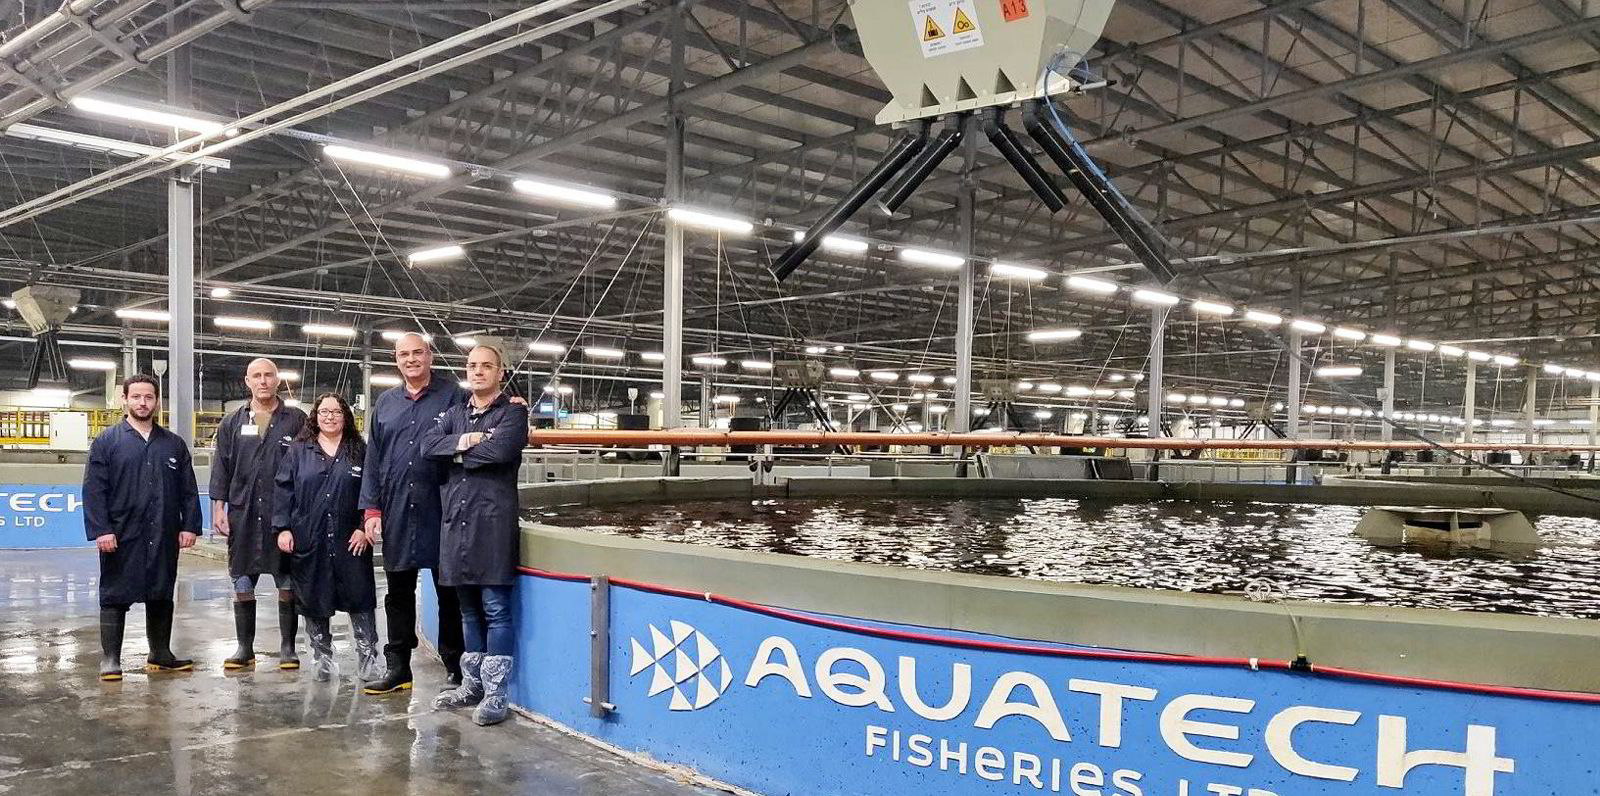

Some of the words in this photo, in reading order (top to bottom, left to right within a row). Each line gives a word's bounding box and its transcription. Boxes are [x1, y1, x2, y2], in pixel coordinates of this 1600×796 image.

[1003, 0, 1025, 18] A13
[15, 516, 45, 527] LTD
[744, 636, 1516, 796] AQUATECH
